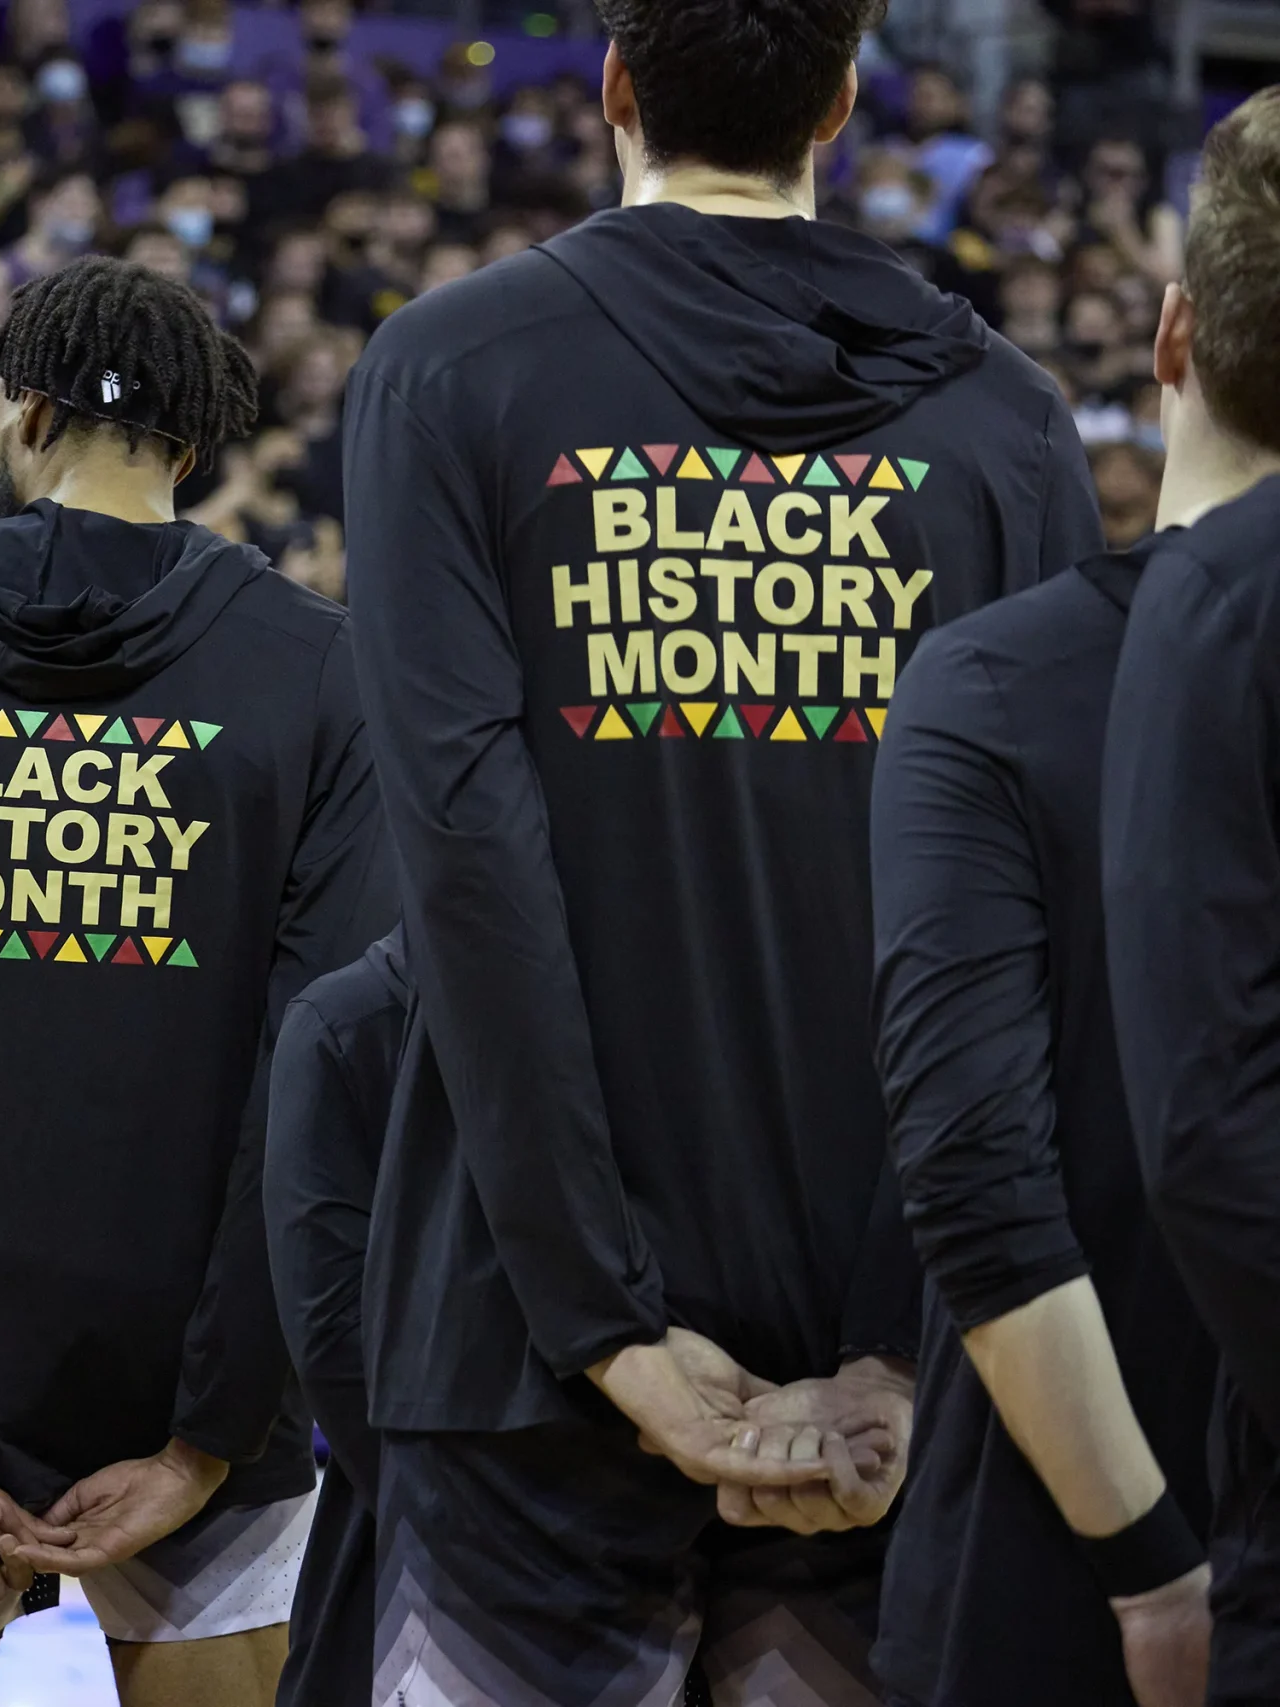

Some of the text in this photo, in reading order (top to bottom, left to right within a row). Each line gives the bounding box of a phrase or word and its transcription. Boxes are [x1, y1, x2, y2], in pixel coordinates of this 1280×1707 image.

[592, 486, 891, 558] BLACK
[551, 557, 933, 630] HISTORY
[587, 629, 896, 699] MONTH
